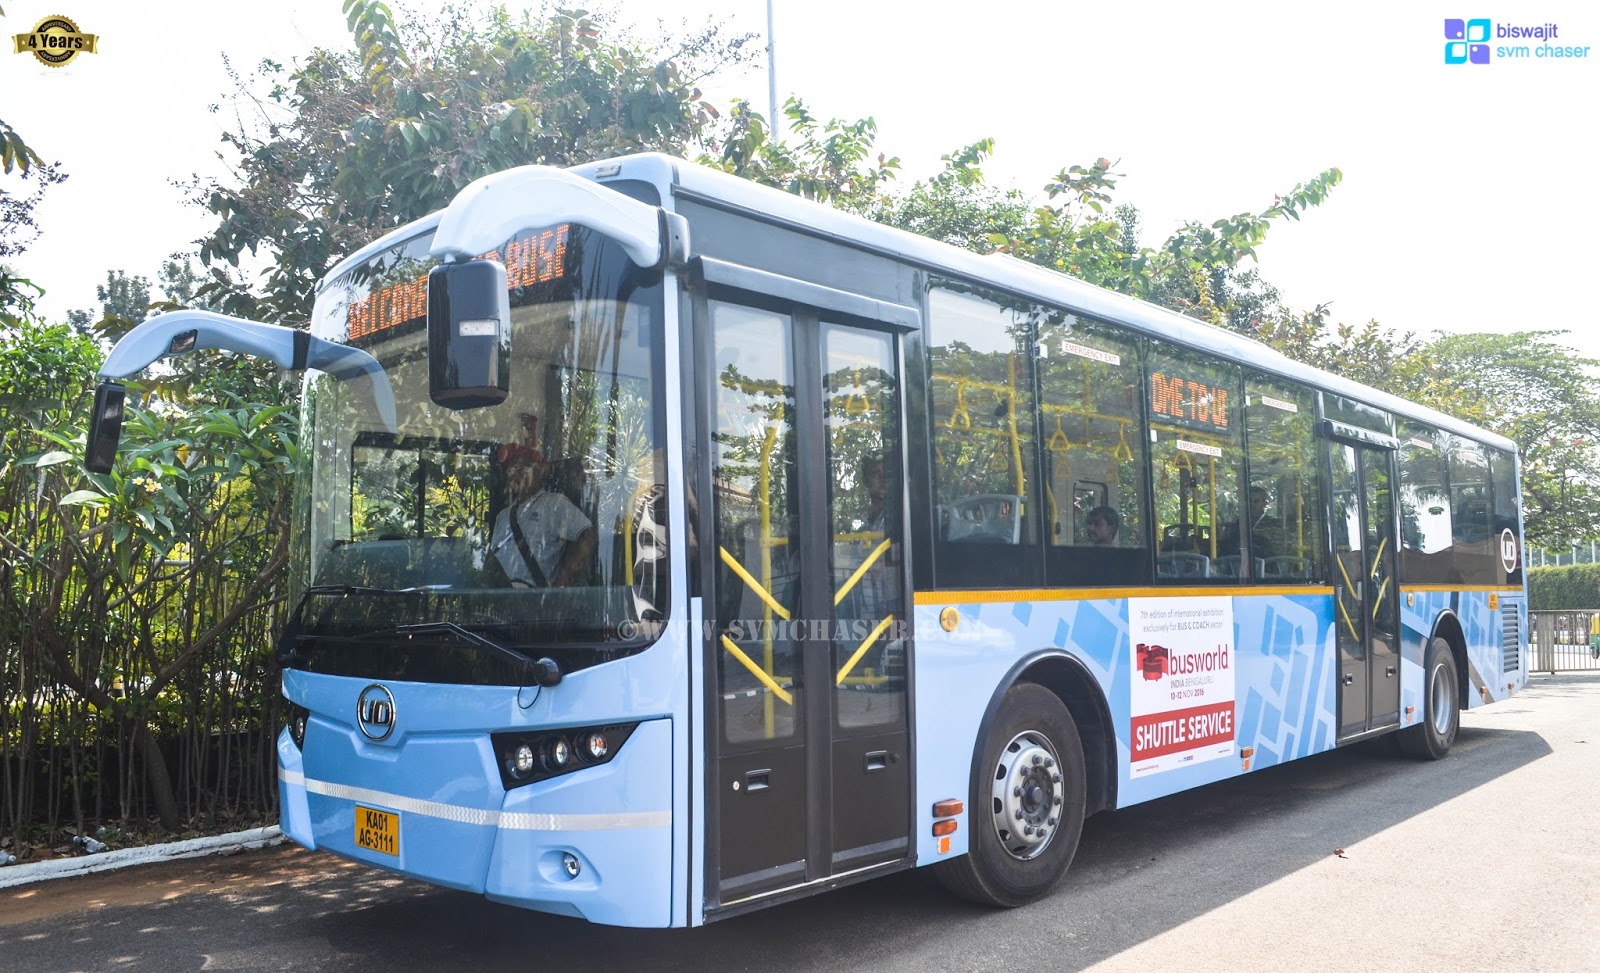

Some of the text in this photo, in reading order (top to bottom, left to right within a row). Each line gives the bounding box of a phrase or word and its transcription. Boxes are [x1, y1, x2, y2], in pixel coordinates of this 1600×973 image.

[1065, 343, 1117, 364] EMERGENCY EXIT
[1179, 441, 1208, 454] EMERGENCY
[1149, 609, 1167, 619] edition
[1168, 608, 1173, 618] of
[1174, 608, 1201, 618] international
[1202, 607, 1224, 617] exhibition
[1143, 622, 1169, 633] exclusively
[1177, 621, 1187, 630] BUS
[1192, 620, 1210, 630] COACH
[1210, 620, 1223, 629] sector
[1169, 643, 1228, 676] busworld
[1170, 679, 1184, 689] INDIA
[1183, 689, 1193, 698] NOV
[1194, 688, 1205, 697] 2016
[1135, 710, 1232, 752] SHUTTLE SERVICE
[366, 810, 389, 833] KA01
[359, 827, 393, 853] AG-3111
